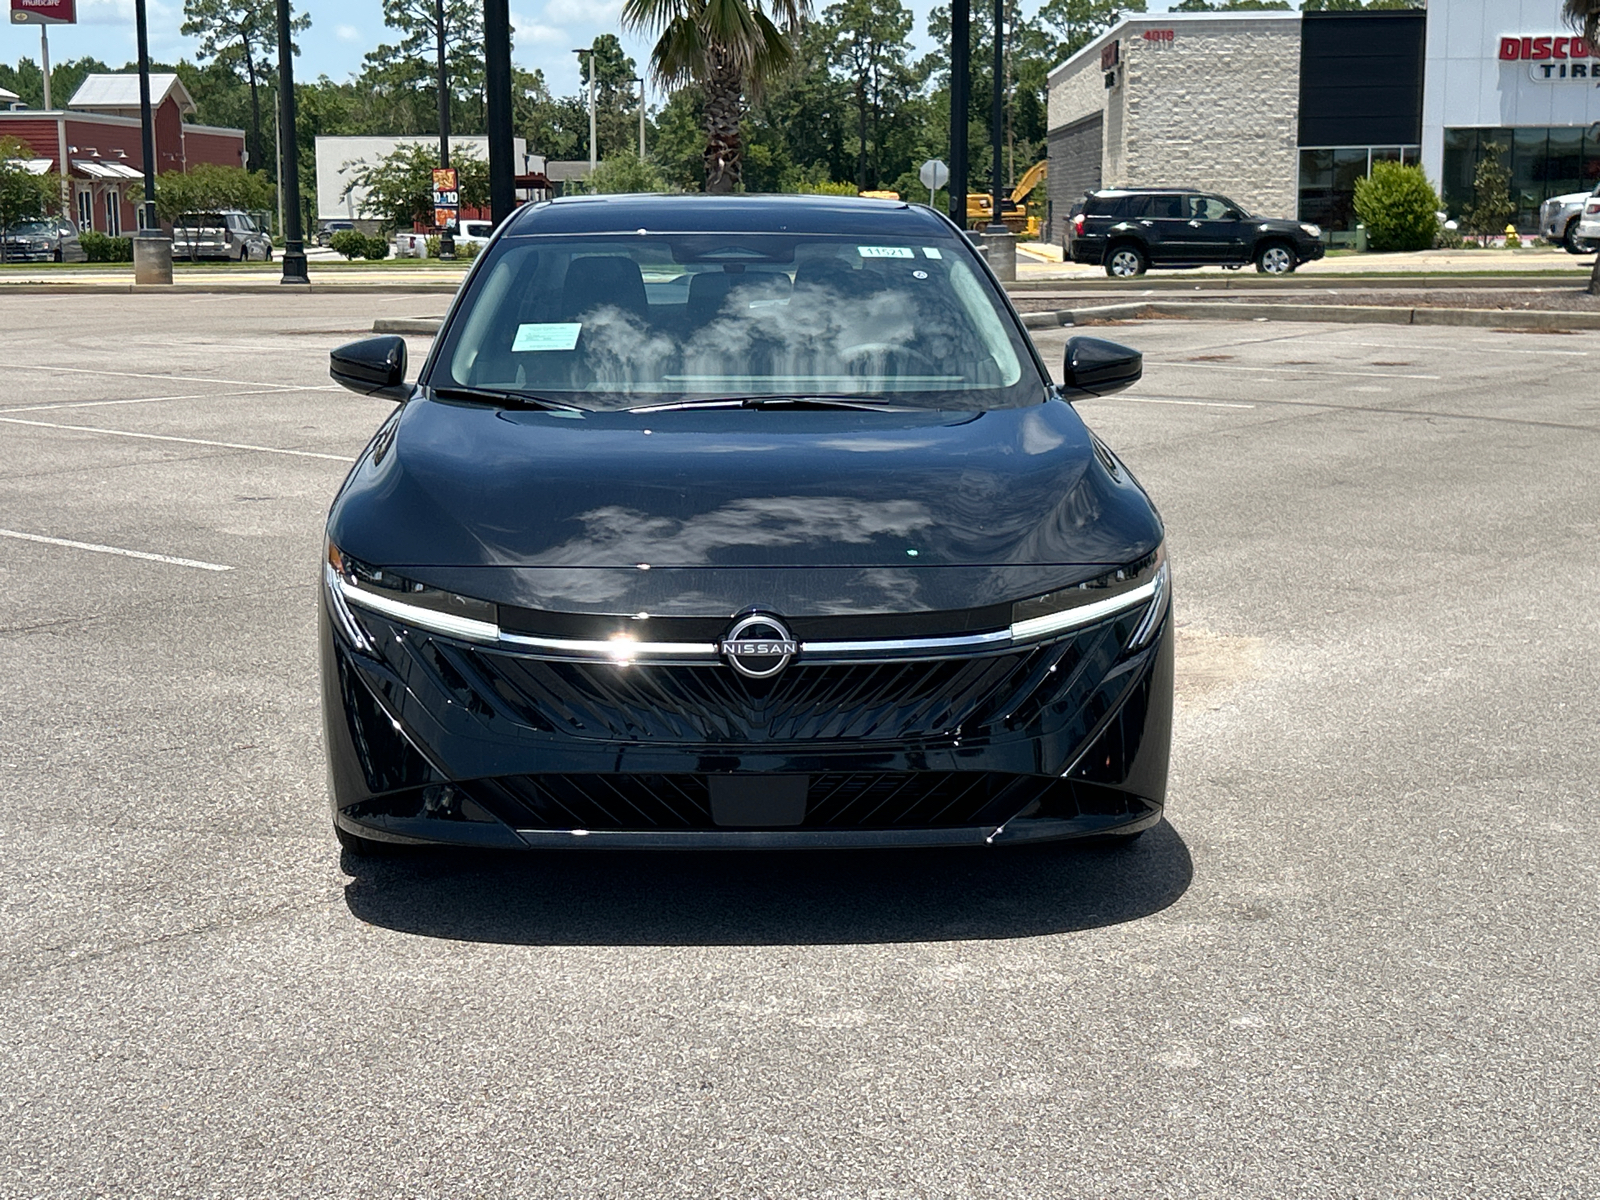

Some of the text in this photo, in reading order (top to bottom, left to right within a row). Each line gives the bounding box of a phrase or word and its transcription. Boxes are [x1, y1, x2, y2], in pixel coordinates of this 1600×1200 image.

[1498, 37, 1600, 60] DISCO
[1540, 63, 1600, 78] TIRE
[723, 643, 796, 654] NISSAN
